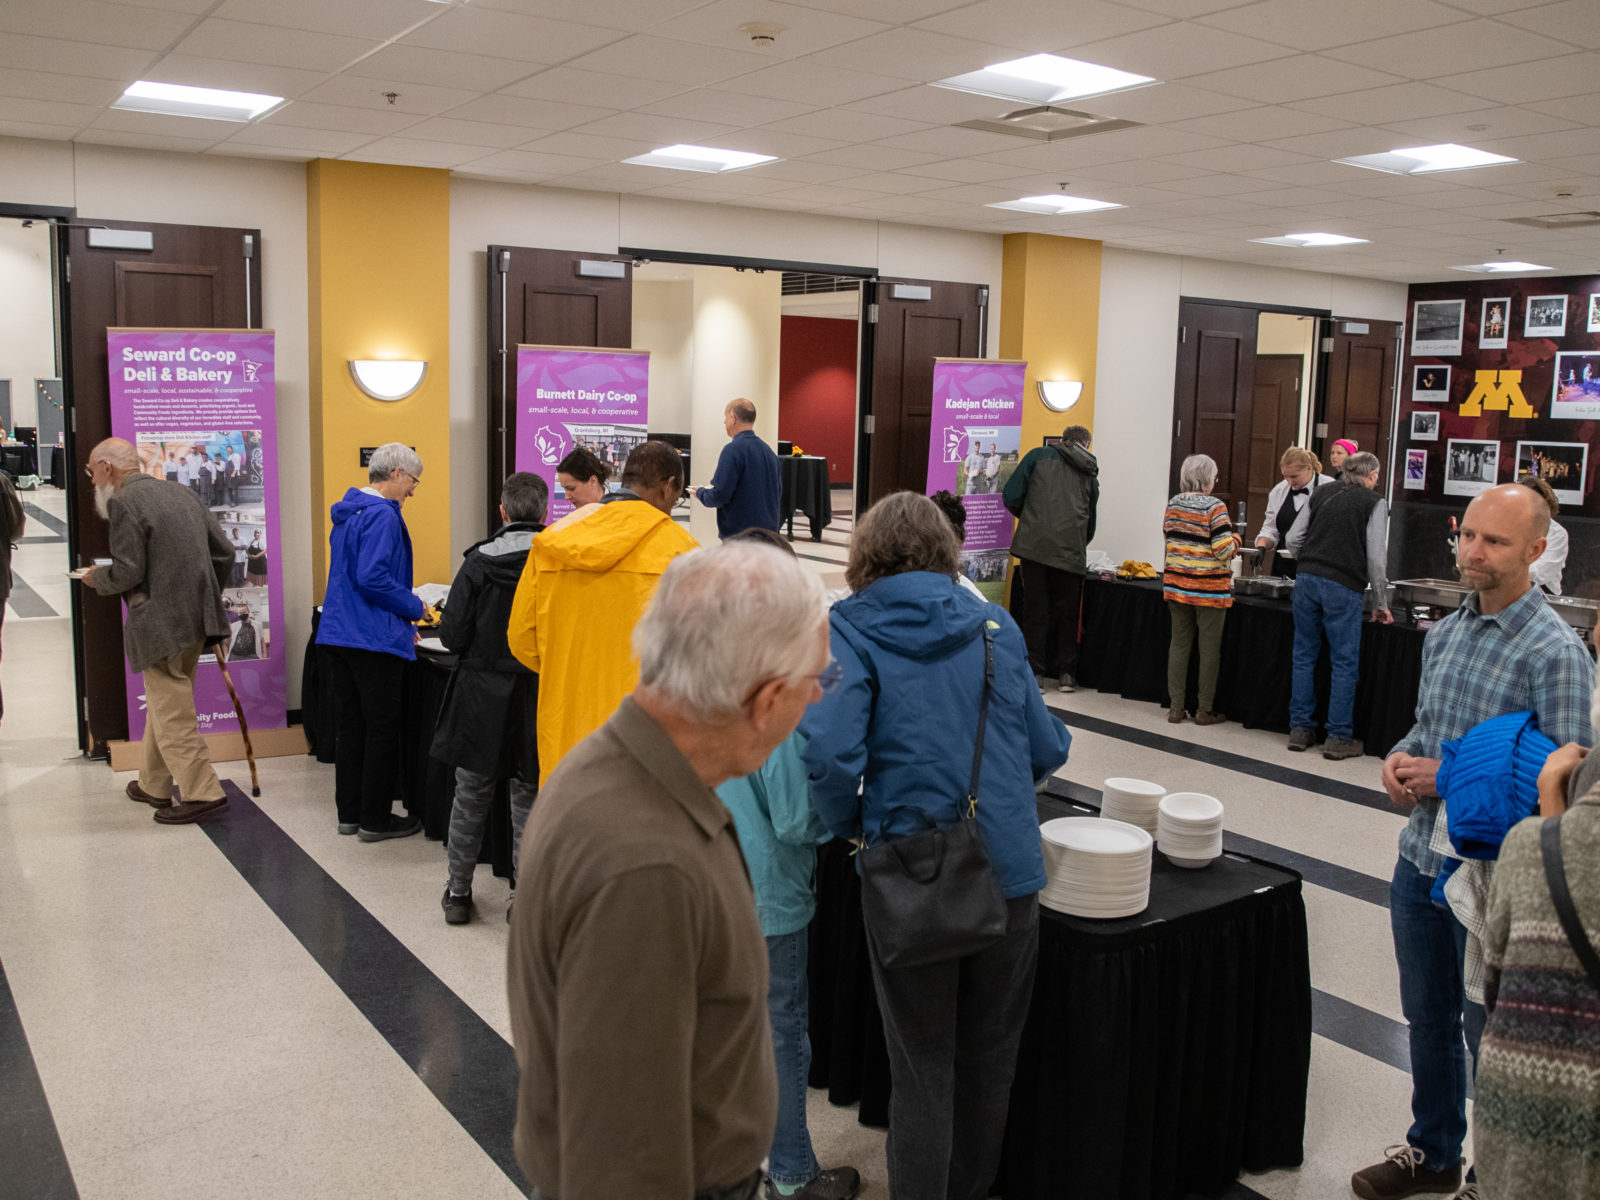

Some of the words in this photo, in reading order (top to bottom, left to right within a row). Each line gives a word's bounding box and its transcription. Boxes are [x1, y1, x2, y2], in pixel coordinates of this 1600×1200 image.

[122, 347, 186, 362] Seward
[189, 347, 237, 365] Co-op
[123, 367, 157, 382] Deli
[160, 367, 173, 382] &
[176, 367, 233, 385] Bakery
[536, 388, 576, 400] Burnett
[578, 390, 605, 403] Dairy
[607, 391, 637, 404] Co-op
[528, 406, 568, 414] small-scale,
[570, 407, 590, 415] local,
[946, 398, 980, 411] Kadejan
[982, 398, 1014, 408] Chicken
